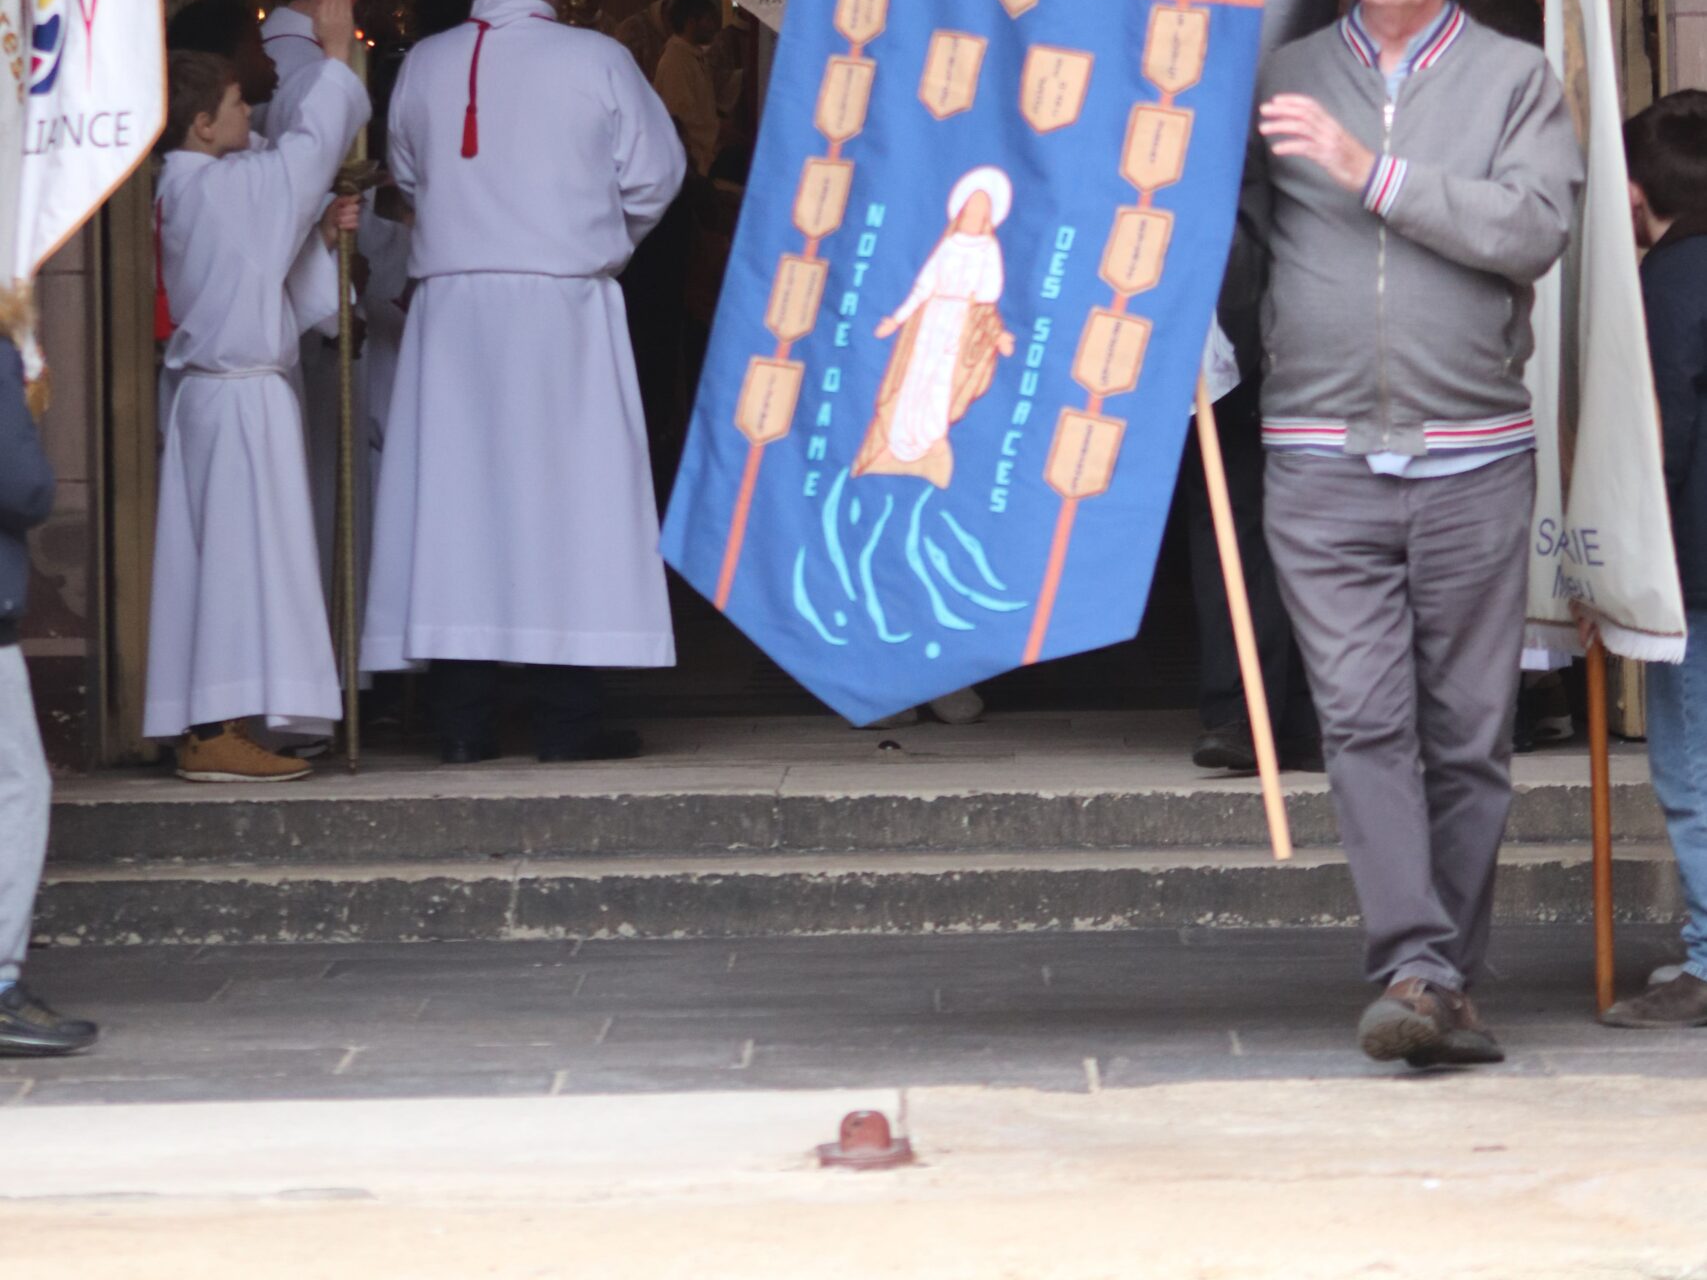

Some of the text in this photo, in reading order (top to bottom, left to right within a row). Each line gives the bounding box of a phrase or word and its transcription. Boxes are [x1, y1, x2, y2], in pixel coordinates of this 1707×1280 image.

[803, 202, 886, 498] NOTRE DAME
[988, 224, 1076, 514] DES SOURCES
